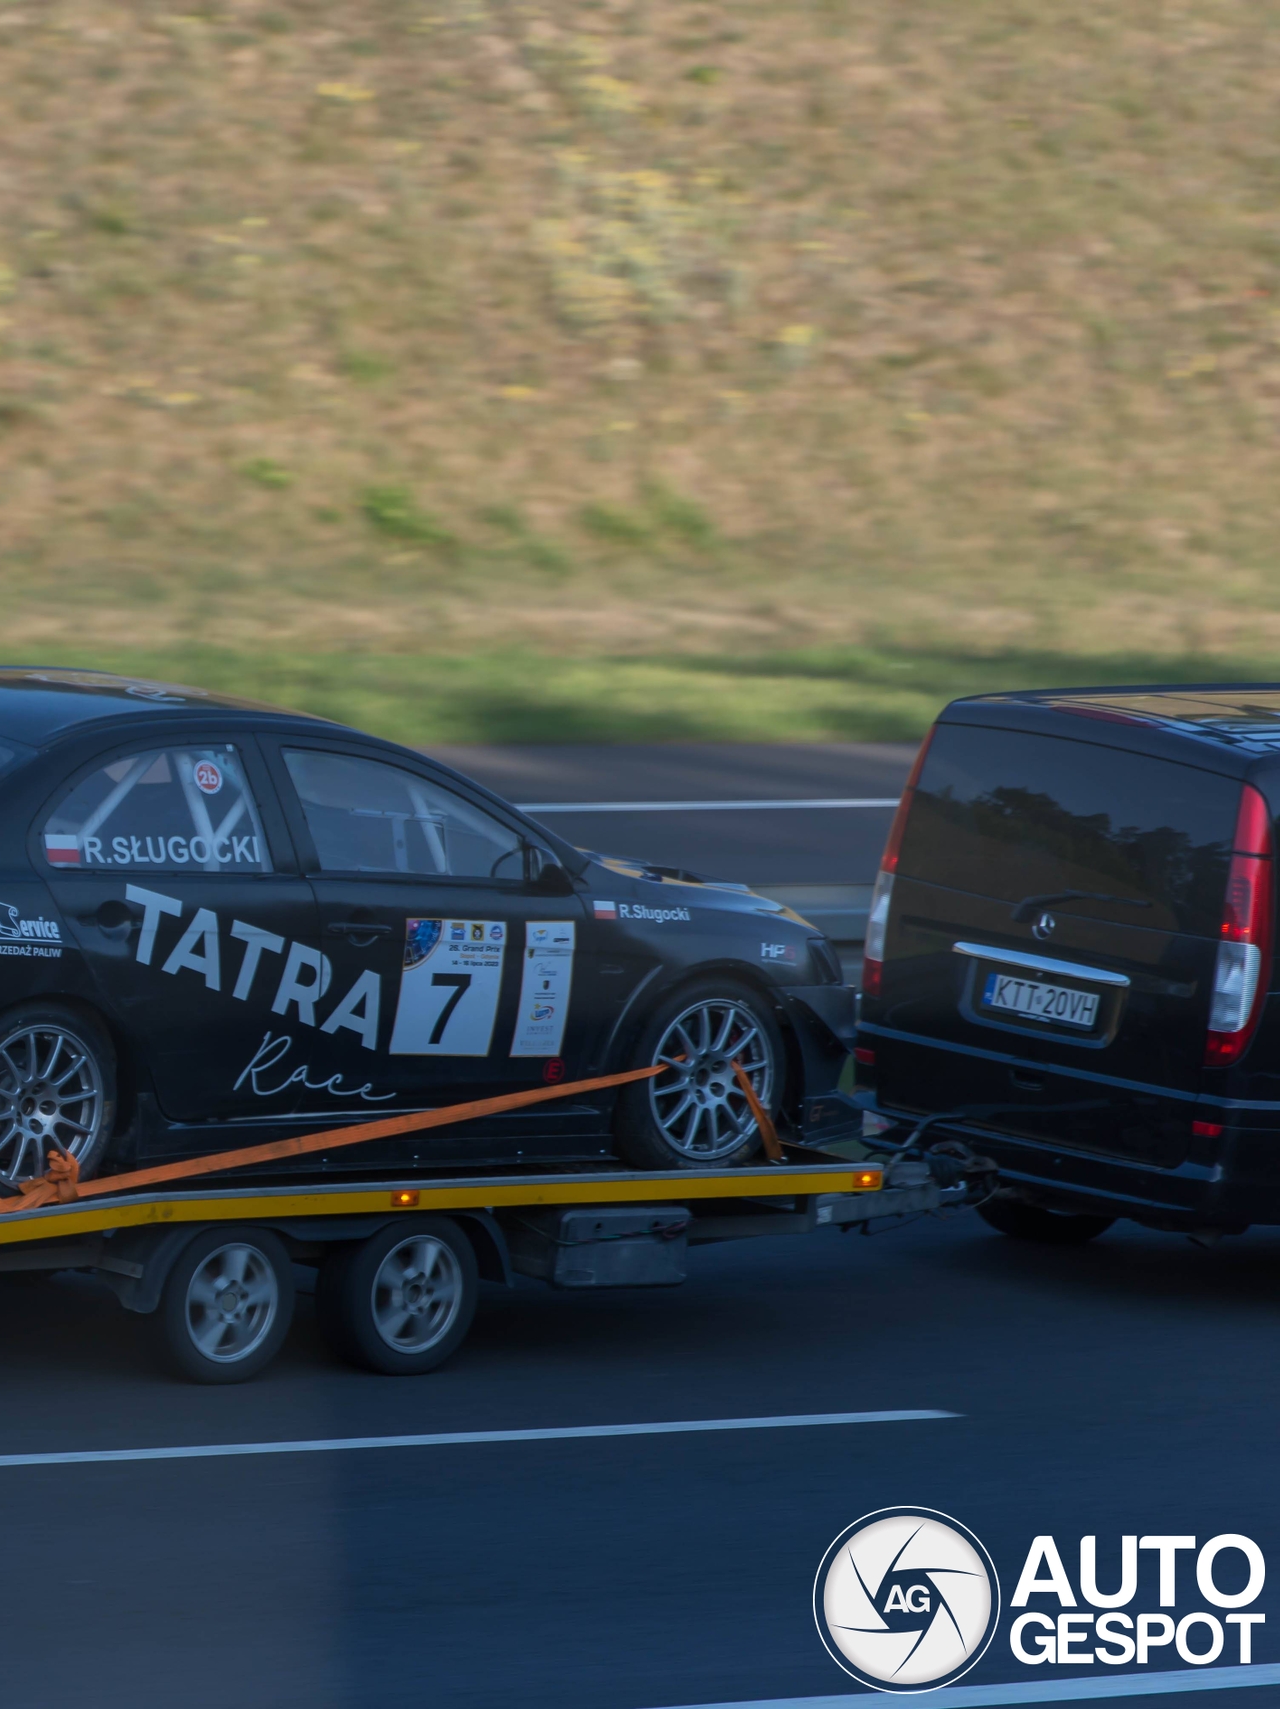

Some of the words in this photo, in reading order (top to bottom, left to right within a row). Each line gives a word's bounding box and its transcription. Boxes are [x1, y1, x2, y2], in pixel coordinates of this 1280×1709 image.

[198, 769, 218, 784] 2b
[83, 835, 262, 865] R.SŁUGOCKI
[33, 947, 63, 958] PALIW
[125, 883, 381, 1051] TATRA
[428, 972, 472, 1045] 7
[995, 977, 1040, 1011] KTT
[1042, 988, 1097, 1024] 20VH
[232, 1031, 397, 1101] Race
[548, 1061, 560, 1079] E
